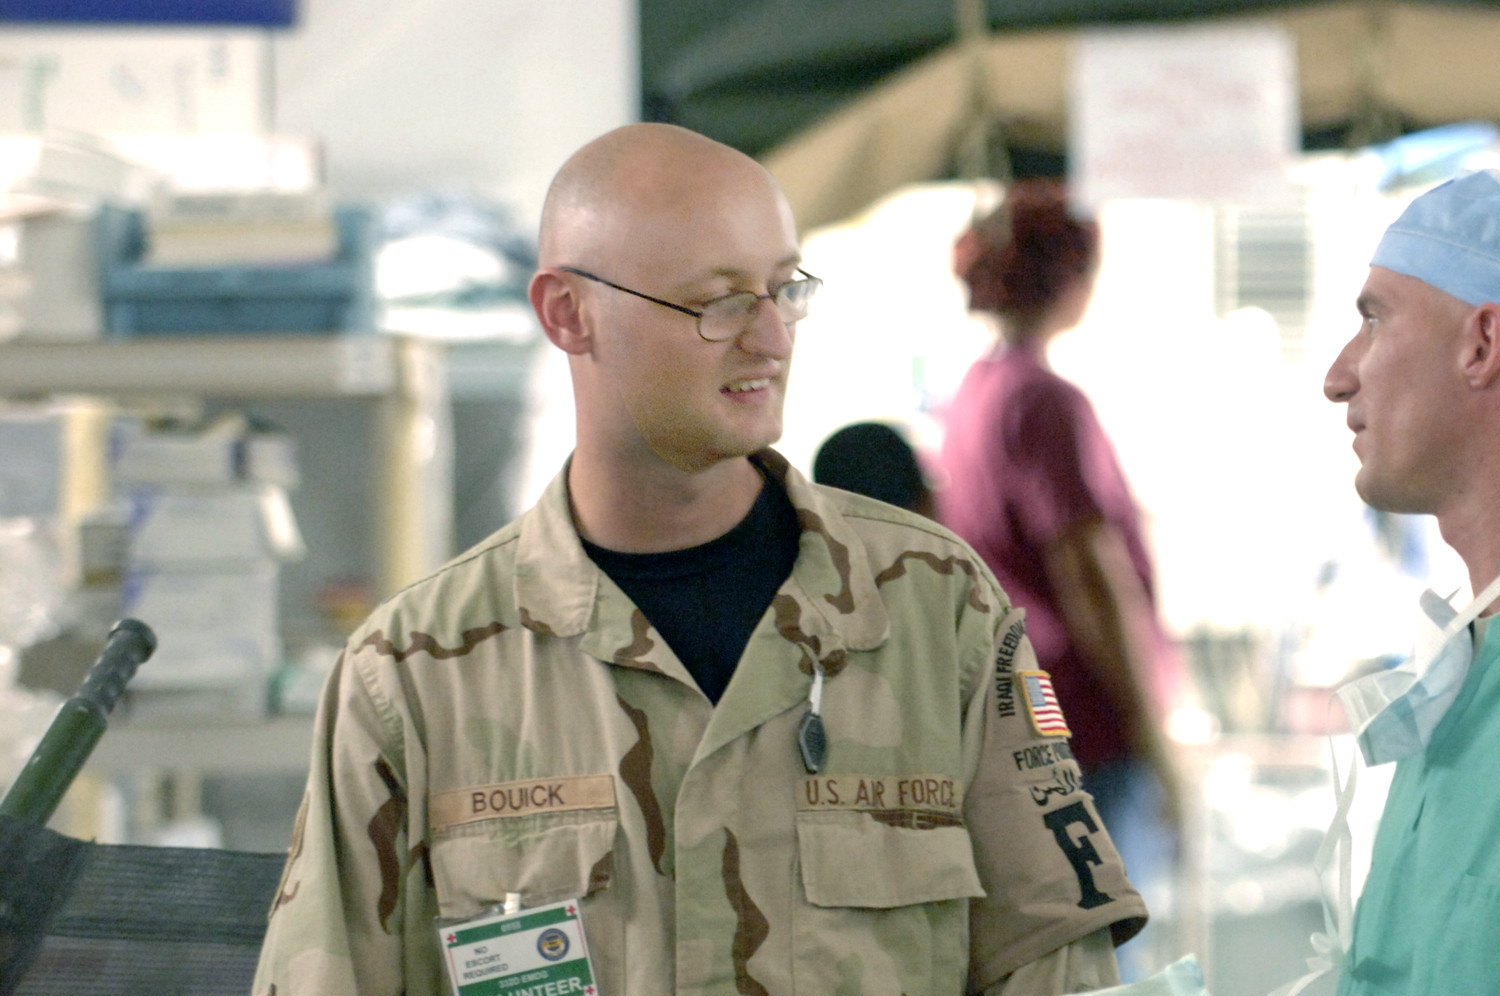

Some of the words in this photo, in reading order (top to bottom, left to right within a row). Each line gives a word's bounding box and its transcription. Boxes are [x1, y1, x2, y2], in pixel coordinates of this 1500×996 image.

[995, 676, 1016, 718] IRAQI
[1013, 744, 1054, 771] FORCE
[805, 779, 844, 806] U.S.
[855, 779, 886, 807] AIR
[899, 779, 956, 808] FORCE
[1042, 801, 1116, 910] F
[466, 954, 501, 968] ESCORT
[474, 946, 489, 955] NO
[463, 964, 509, 979] REQUIRED
